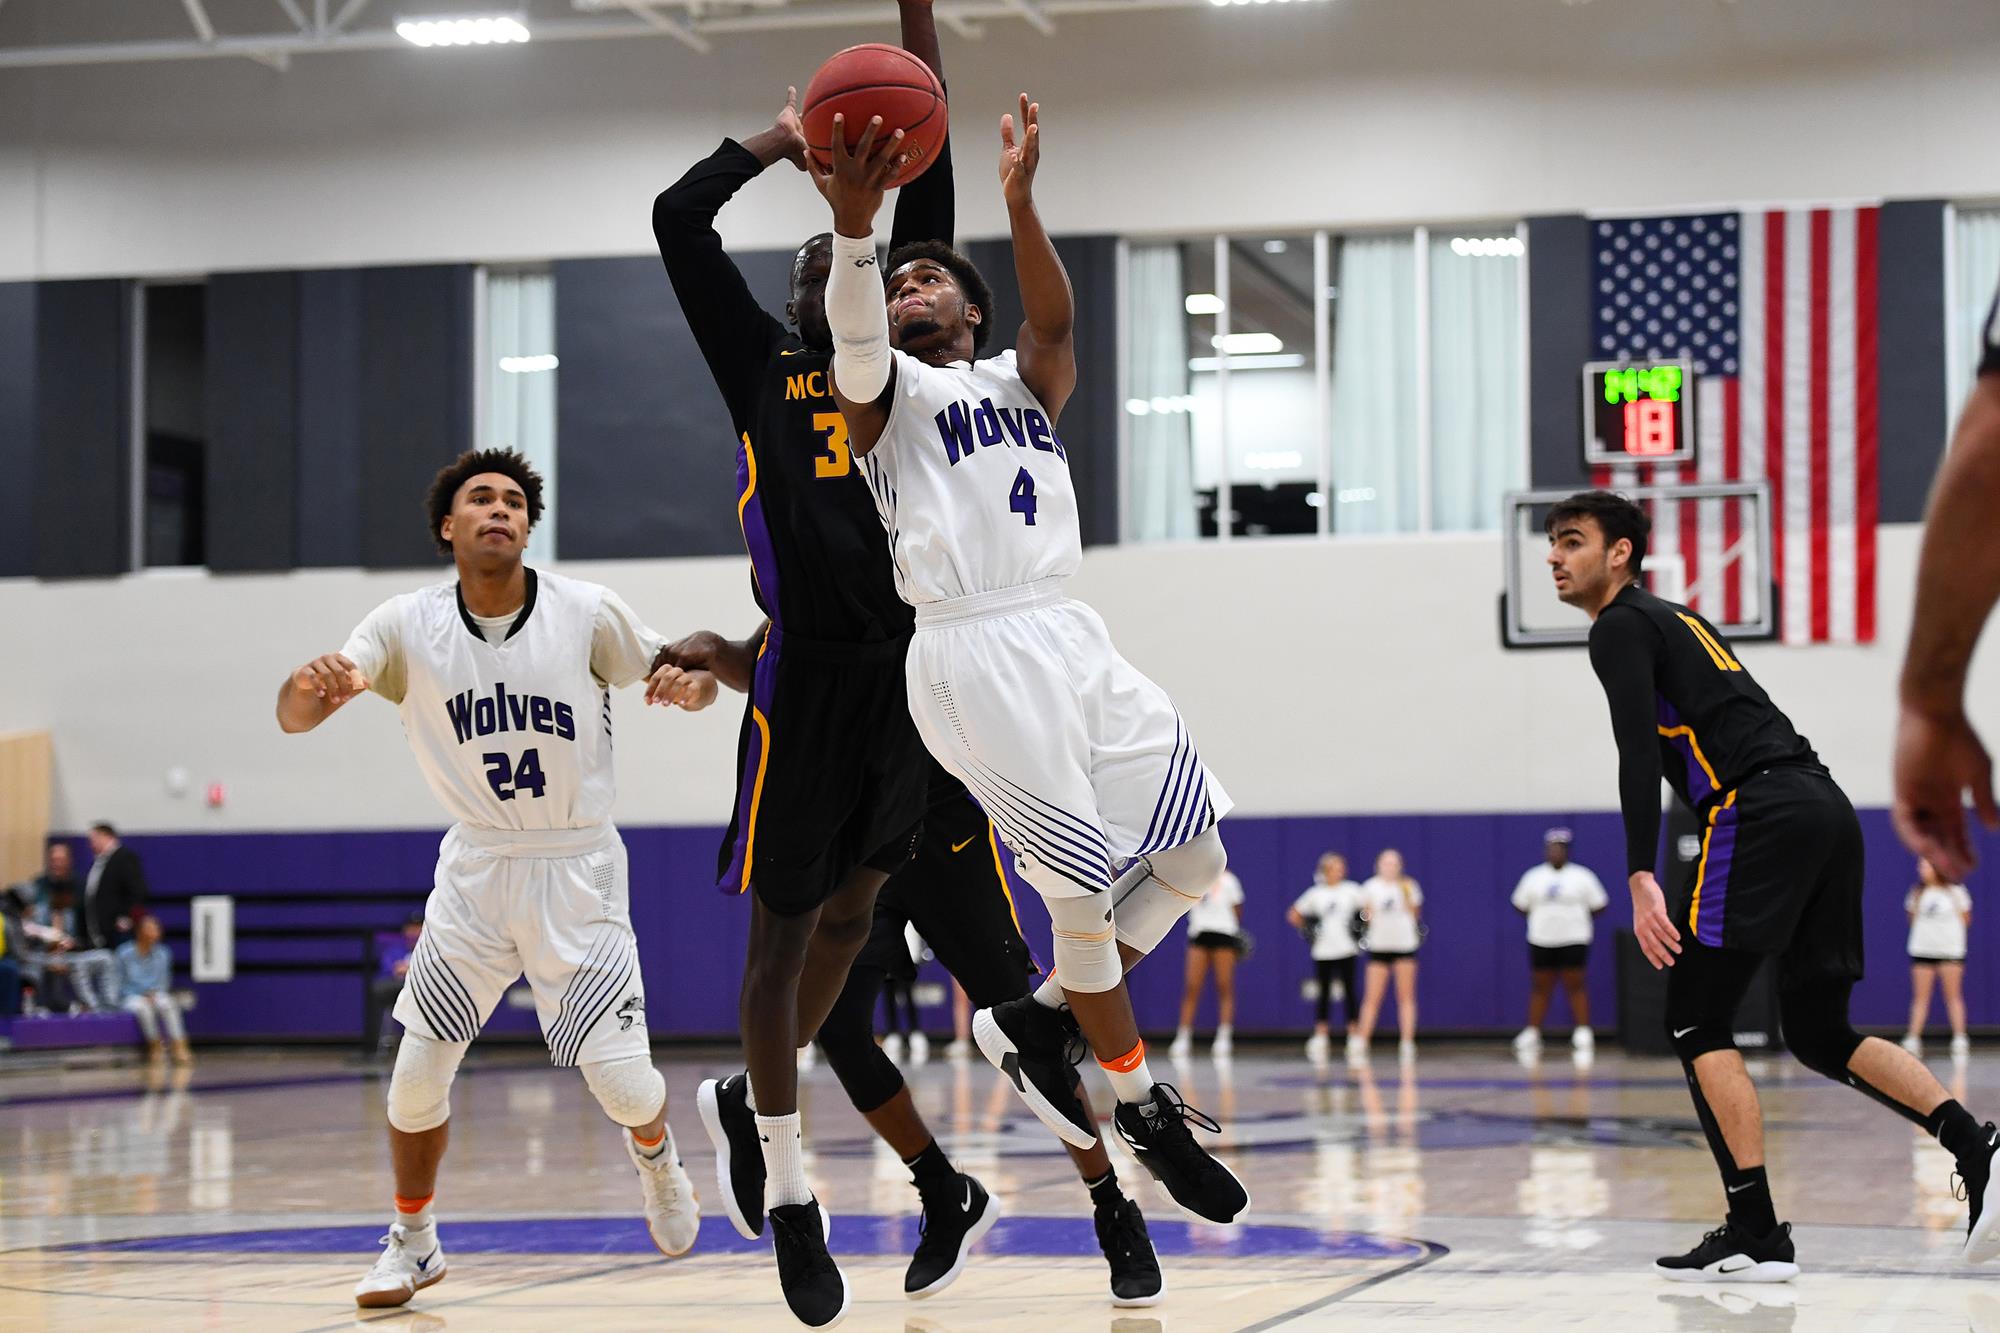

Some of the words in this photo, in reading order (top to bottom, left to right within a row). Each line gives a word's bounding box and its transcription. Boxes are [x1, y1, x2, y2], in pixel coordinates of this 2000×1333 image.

[785, 371, 834, 401] MC
[1009, 465, 1038, 526] 4
[445, 682, 577, 746] Wolves
[482, 748, 547, 802] 24
